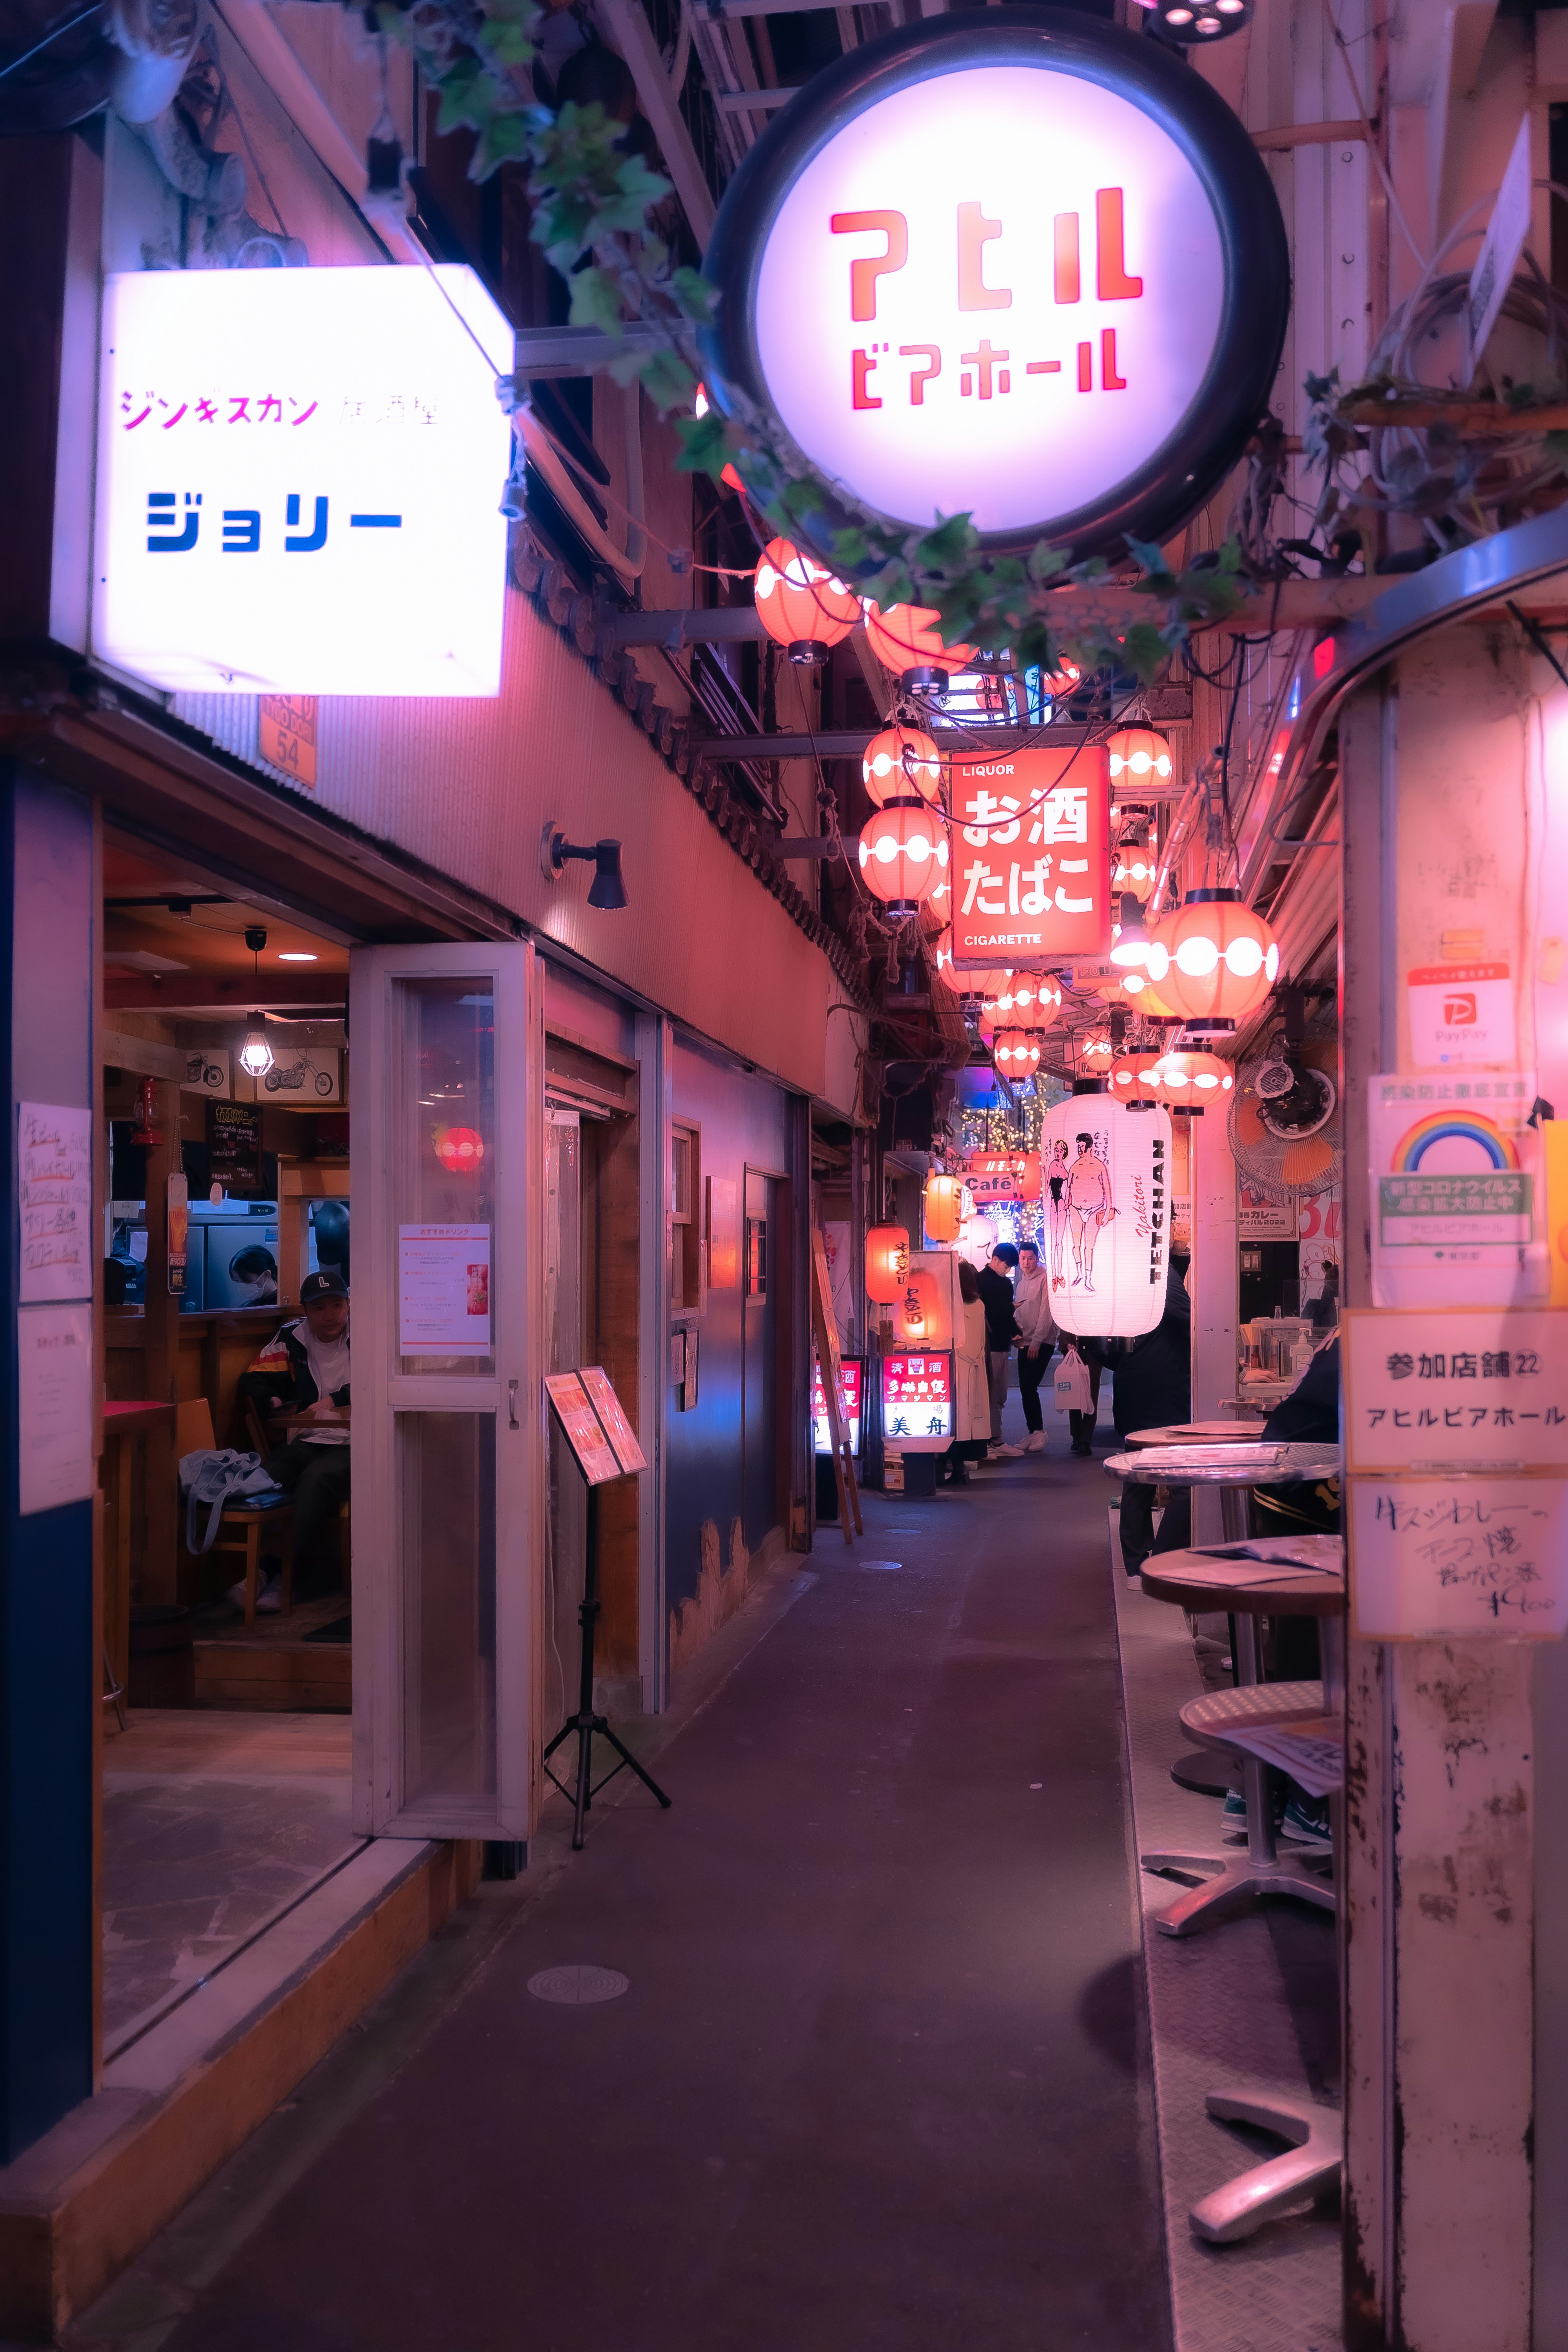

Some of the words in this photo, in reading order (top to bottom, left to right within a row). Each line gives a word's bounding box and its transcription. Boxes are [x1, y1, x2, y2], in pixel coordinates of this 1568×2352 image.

[830, 187, 1143, 322] アヒル
[852, 328, 1127, 410] ビアホール
[147, 492, 402, 553] ジョリー
[276, 729, 299, 770] 54
[962, 764, 1015, 777] LIQUOR
[962, 787, 1088, 848] お酒
[960, 853, 1093, 916] たばこ
[964, 933, 1042, 946] CIGARETTE
[1435, 1029, 1486, 1043] PayPay
[965, 1176, 1011, 1191] Café
[1397, 1196, 1514, 1212] 感染拡大防止中
[1131, 1174, 1153, 1238] Yakitori
[1149, 1139, 1165, 1285] TETCHAN
[318, 1276, 330, 1287] L
[1367, 1406, 1566, 1428] アヒルビアホール
